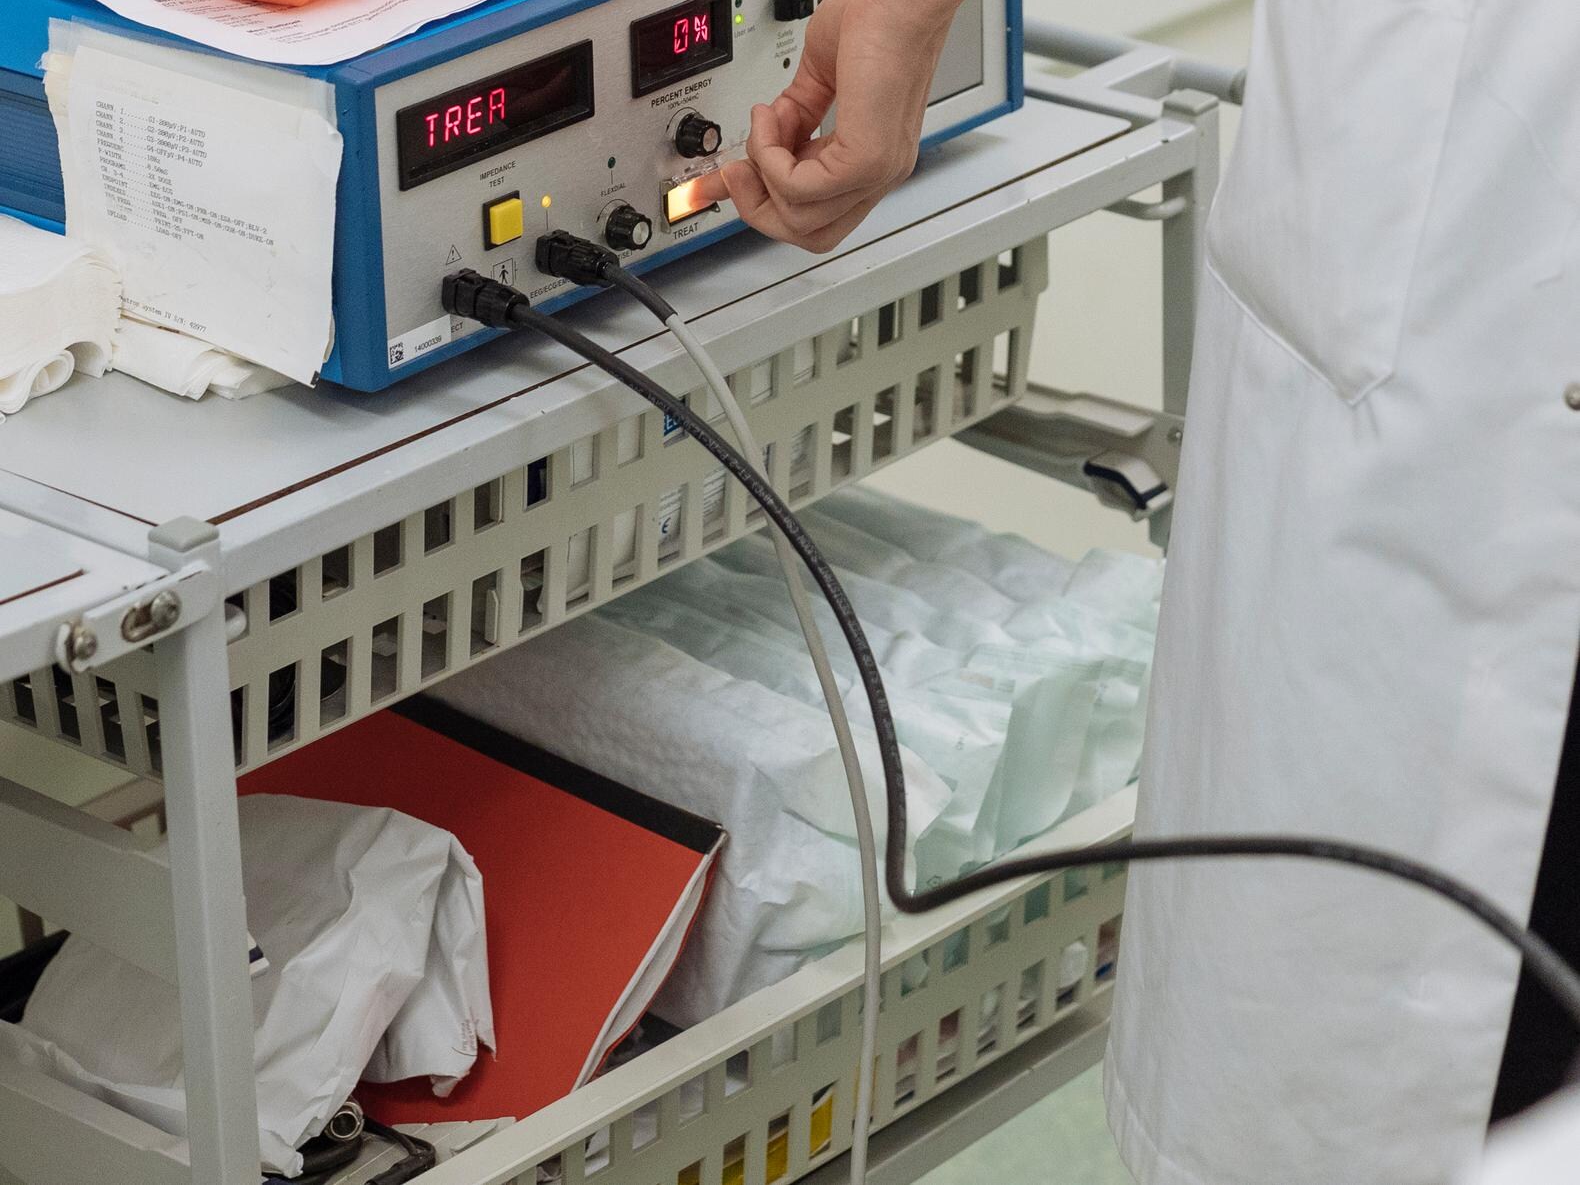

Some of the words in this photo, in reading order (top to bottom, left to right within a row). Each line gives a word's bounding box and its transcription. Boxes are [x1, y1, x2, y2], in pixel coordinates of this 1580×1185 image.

[651, 88, 683, 108] PERCENT
[684, 76, 712, 95] ENERGY
[425, 87, 505, 147] TREA
[480, 160, 516, 181] IMPEDANCE
[489, 176, 505, 188] TEST
[600, 182, 626, 197] FLEXDIAL
[673, 222, 699, 240] TREAT
[451, 321, 463, 333] ECT
